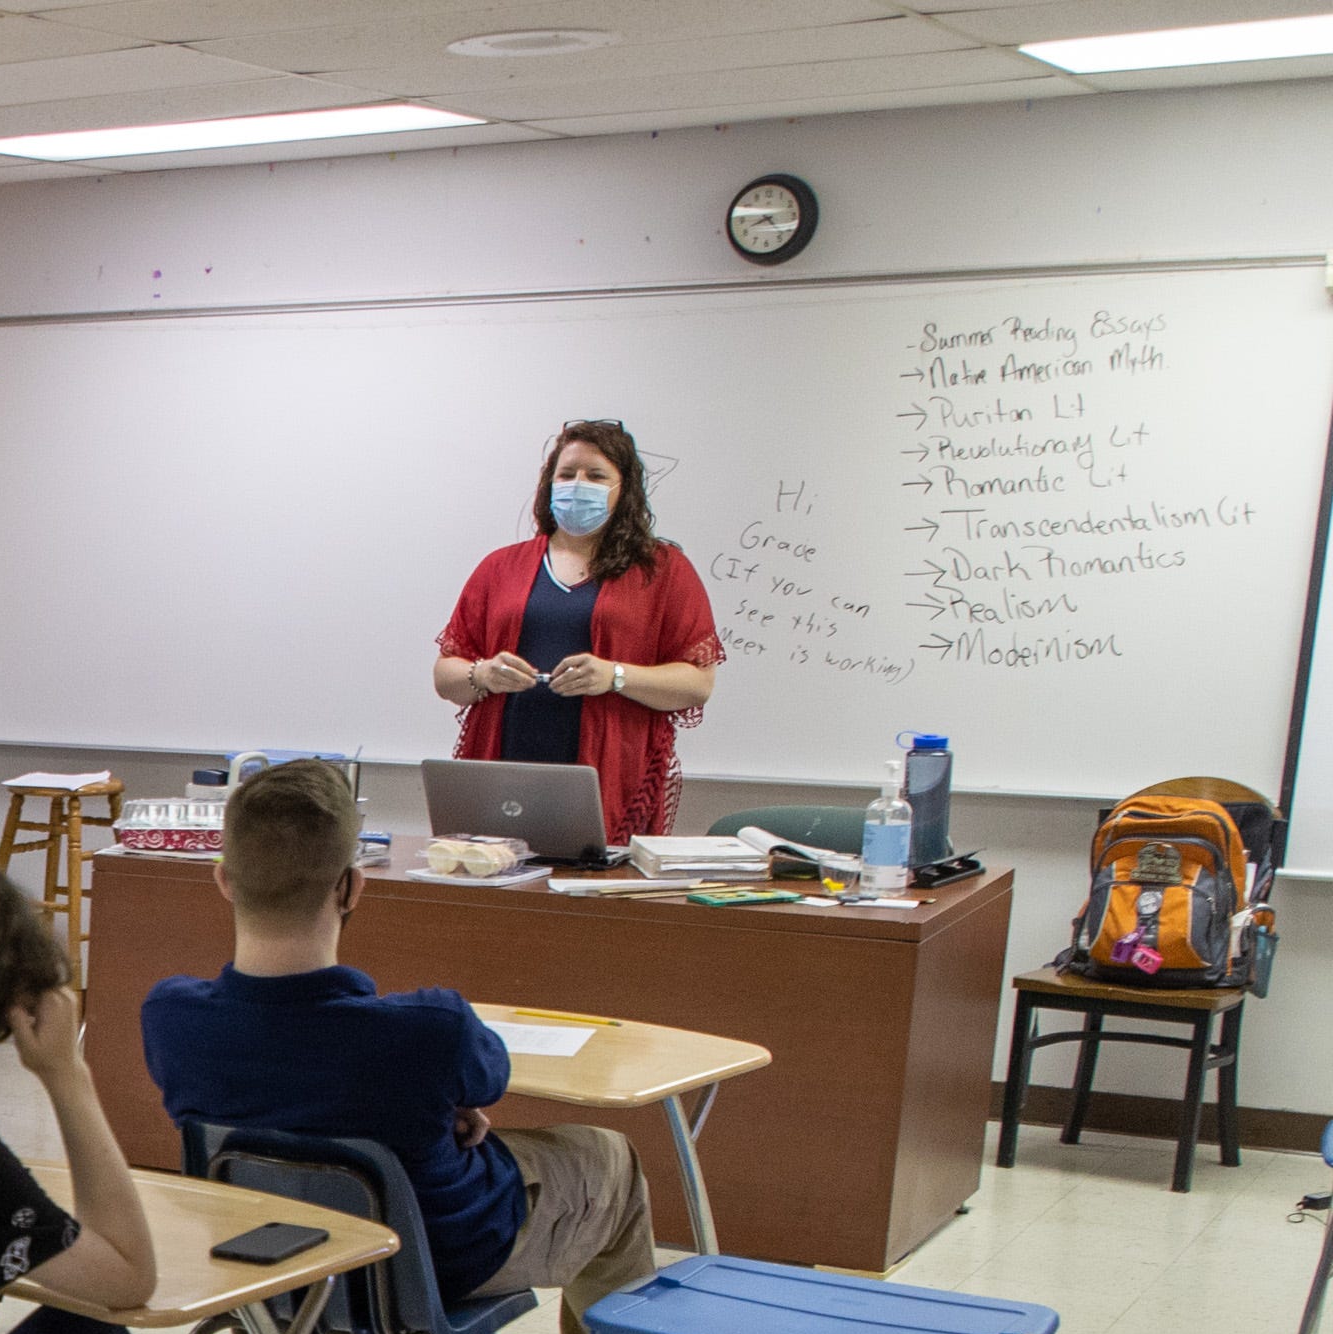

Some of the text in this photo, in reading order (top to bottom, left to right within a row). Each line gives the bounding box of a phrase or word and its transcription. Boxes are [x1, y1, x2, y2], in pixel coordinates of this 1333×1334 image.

[1002, 316, 1078, 358] Reading
[1090, 310, 1168, 342] Essays
[929, 356, 988, 388] Native
[999, 353, 1093, 384] American
[928, 392, 1085, 429] Puritan Lit
[928, 422, 1150, 470] Revolutionary Lit
[929, 464, 1128, 499] Romantic Lit
[941, 501, 1210, 540] Transcendentalism
[739, 521, 817, 563] Grace
[942, 542, 1187, 582] Dark Romantics
[770, 576, 813, 596] you
[831, 596, 871, 619] can
[935, 585, 1078, 625] Realism
[735, 599, 838, 638] see this
[790, 645, 809, 664] is
[956, 628, 1124, 668] Modernism
